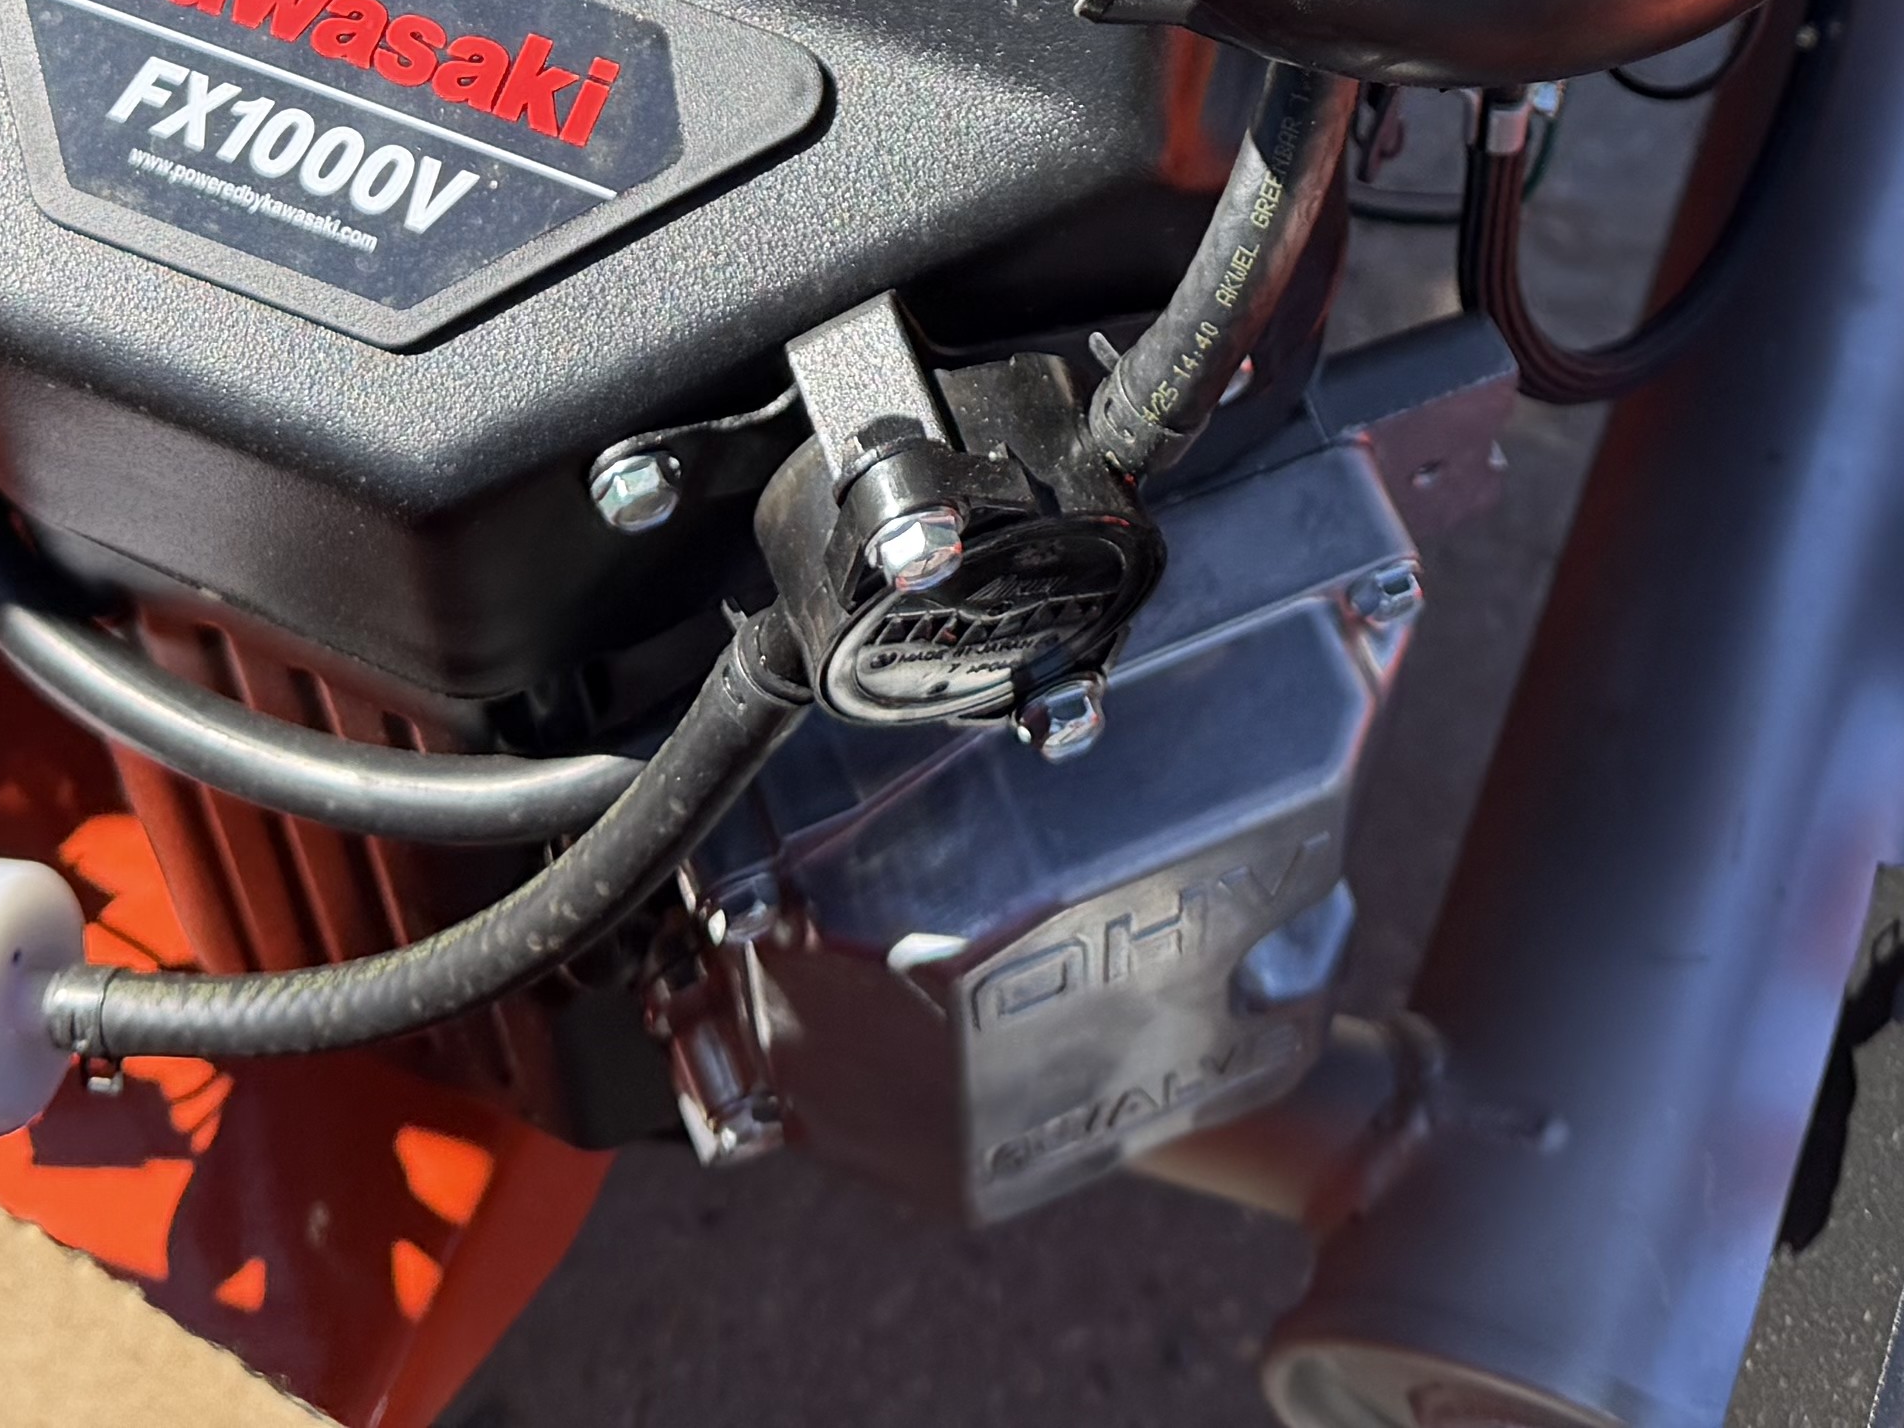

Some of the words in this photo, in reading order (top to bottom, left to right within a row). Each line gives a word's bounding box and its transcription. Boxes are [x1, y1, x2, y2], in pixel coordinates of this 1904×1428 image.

[105, 56, 479, 234] FX1000V
[127, 145, 379, 253] www.poweredbykawasaki.com
[1214, 242, 1261, 309] AKWEL
[971, 830, 1330, 1033] OHV
